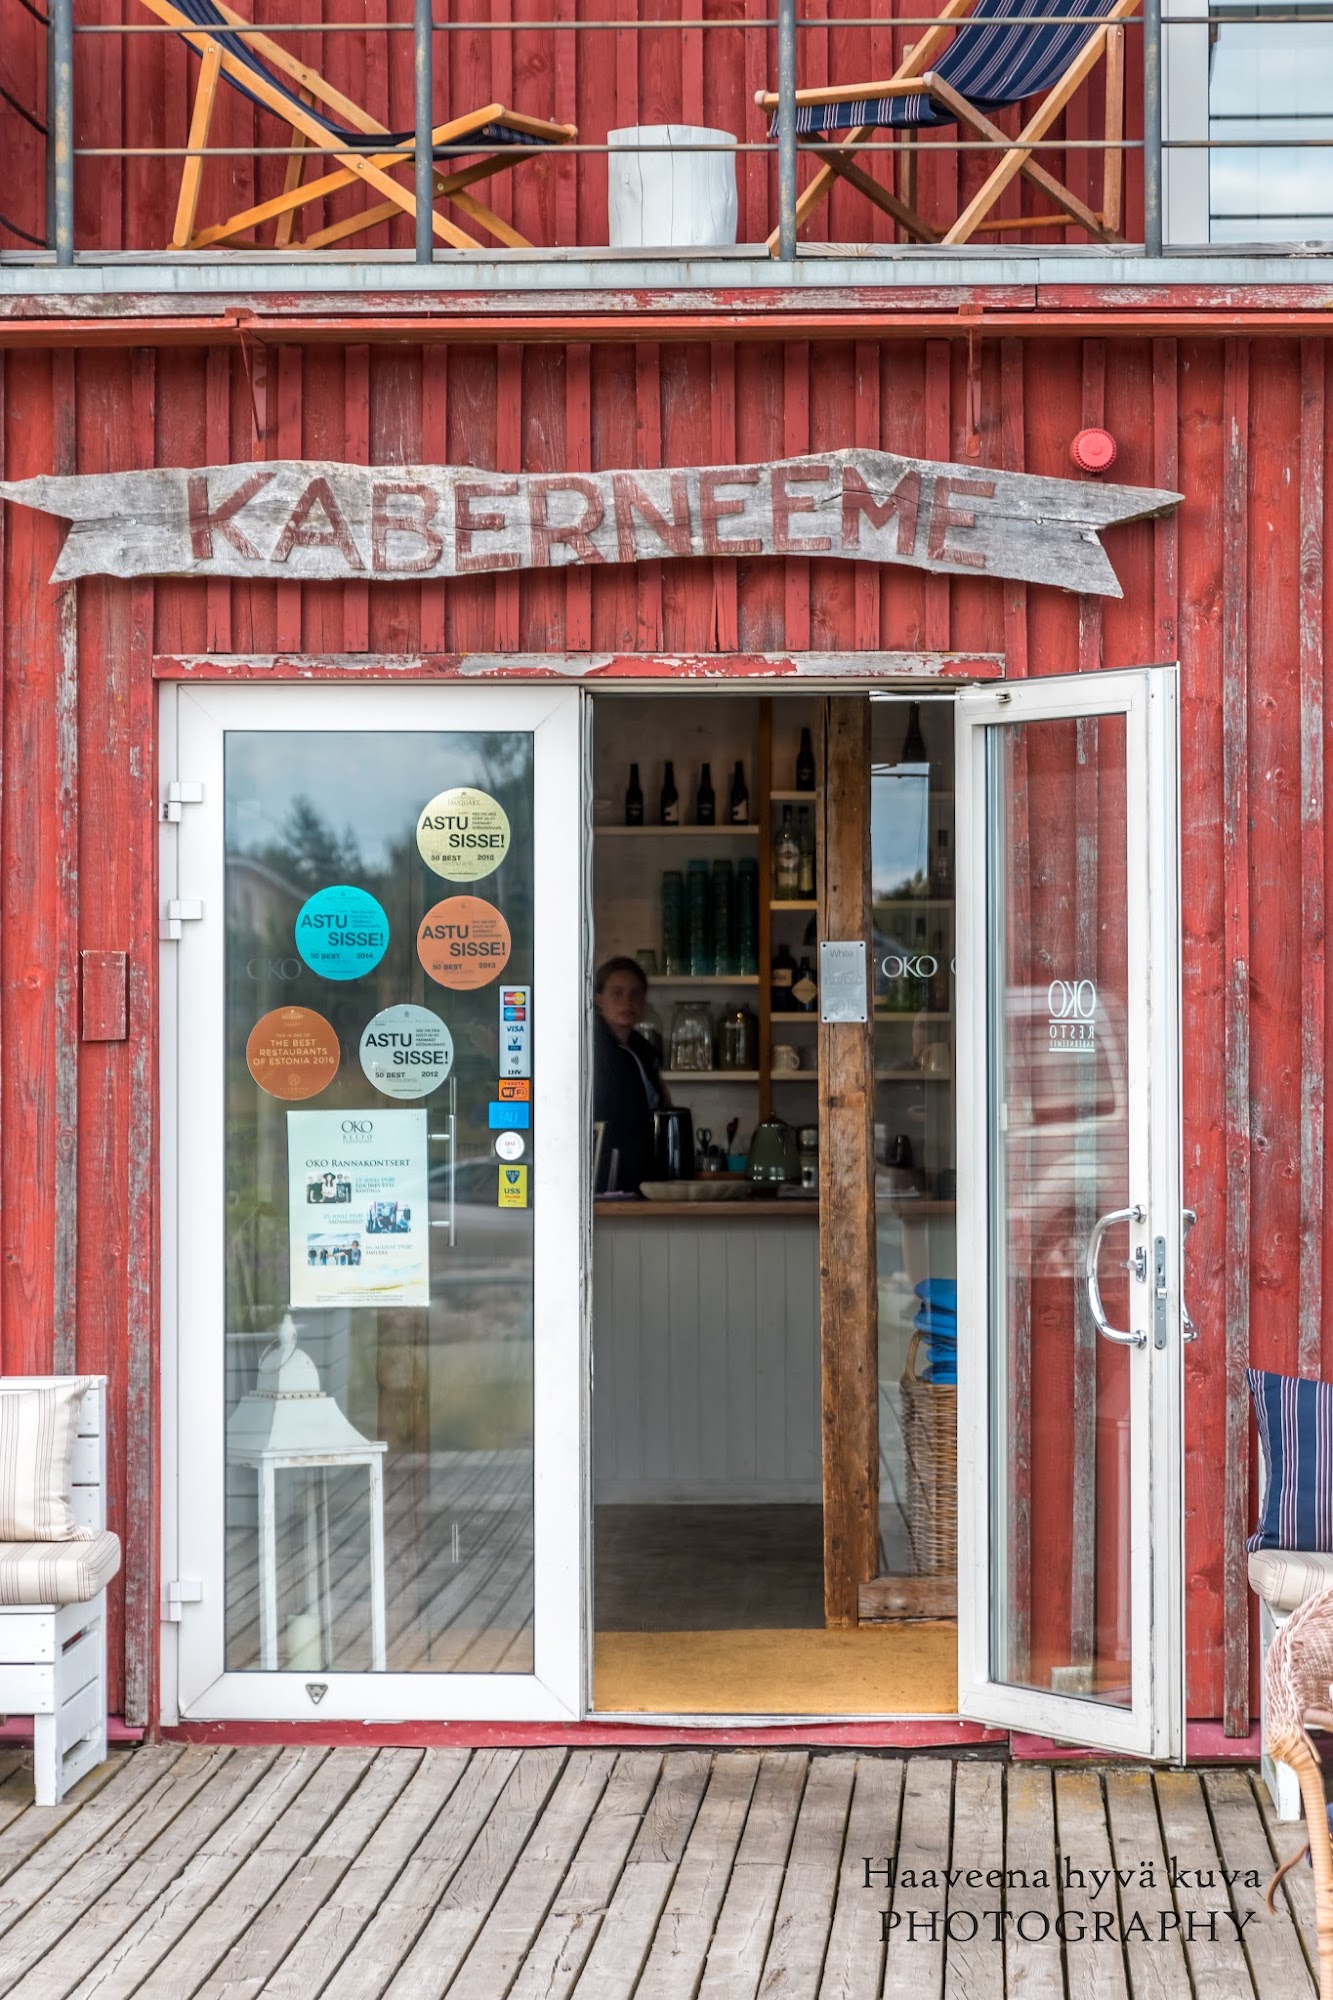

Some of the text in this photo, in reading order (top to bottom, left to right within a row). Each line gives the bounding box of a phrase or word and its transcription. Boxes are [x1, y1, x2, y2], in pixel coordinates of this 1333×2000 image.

[187, 465, 995, 571] KABERNEEME
[421, 816, 468, 830] ASTU
[449, 834, 505, 848] SISSE!
[300, 914, 348, 929] ASTU
[422, 925, 469, 939] ASTU
[328, 932, 384, 947] SISSE!
[450, 942, 506, 957] SISSE!
[830, 949, 853, 958] White
[881, 955, 938, 978] OKO
[270, 1038, 316, 1047] THE BEST
[365, 1033, 412, 1047] ASTU
[259, 1048, 328, 1057] RESTAURANTS
[393, 1051, 448, 1065] SISSE!
[252, 1056, 335, 1066] OF ESTONIA 2016
[341, 1120, 373, 1133] OKO
[306, 1159, 328, 1167] OKO
